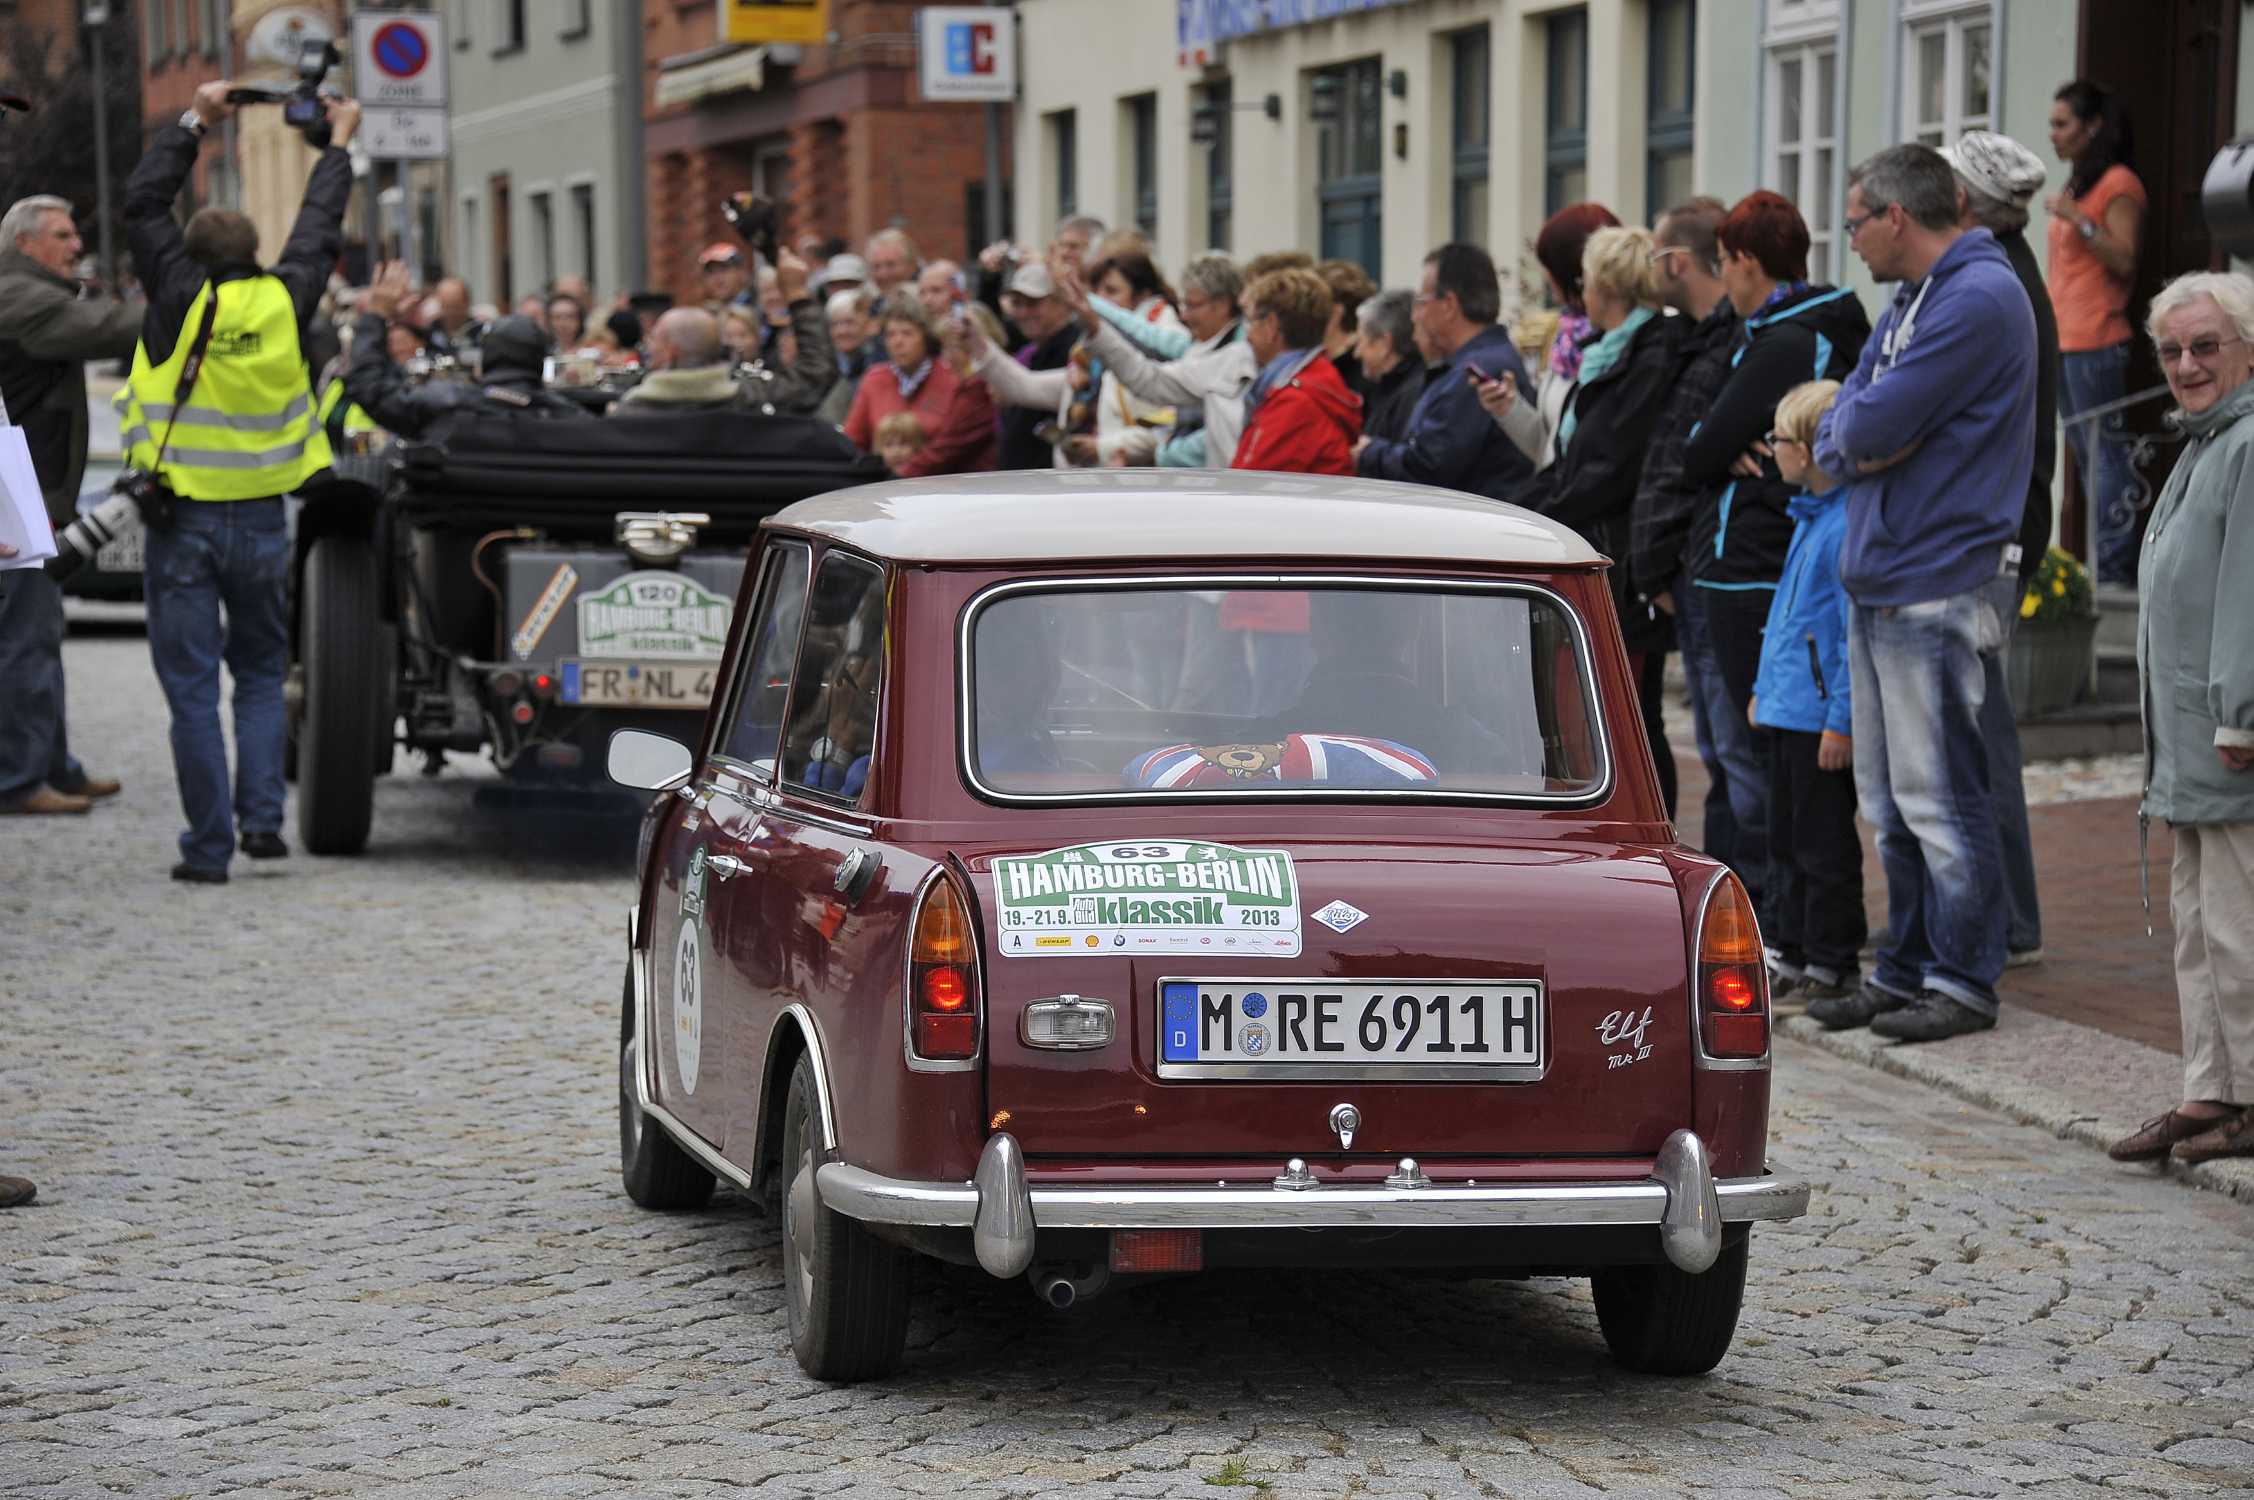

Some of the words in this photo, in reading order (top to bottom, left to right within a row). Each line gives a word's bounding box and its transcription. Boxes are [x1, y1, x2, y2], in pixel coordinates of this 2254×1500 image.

[639, 586, 676, 600] 120
[582, 669, 621, 698] FR
[643, 669, 684, 699] NL
[693, 671, 716, 698] 4
[1111, 846, 1170, 859] 63
[1007, 855, 1283, 901] HAMBURG-BERLIN
[1004, 909, 1072, 926] 19.-21.9.
[1096, 896, 1225, 925] klassik
[1240, 909, 1281, 927] 2013
[1201, 993, 1233, 1052] M
[1277, 994, 1345, 1052] RE
[1594, 1005, 1654, 1049] Elf
[1174, 1031, 1187, 1048] D
[1636, 1044, 1654, 1061] III
